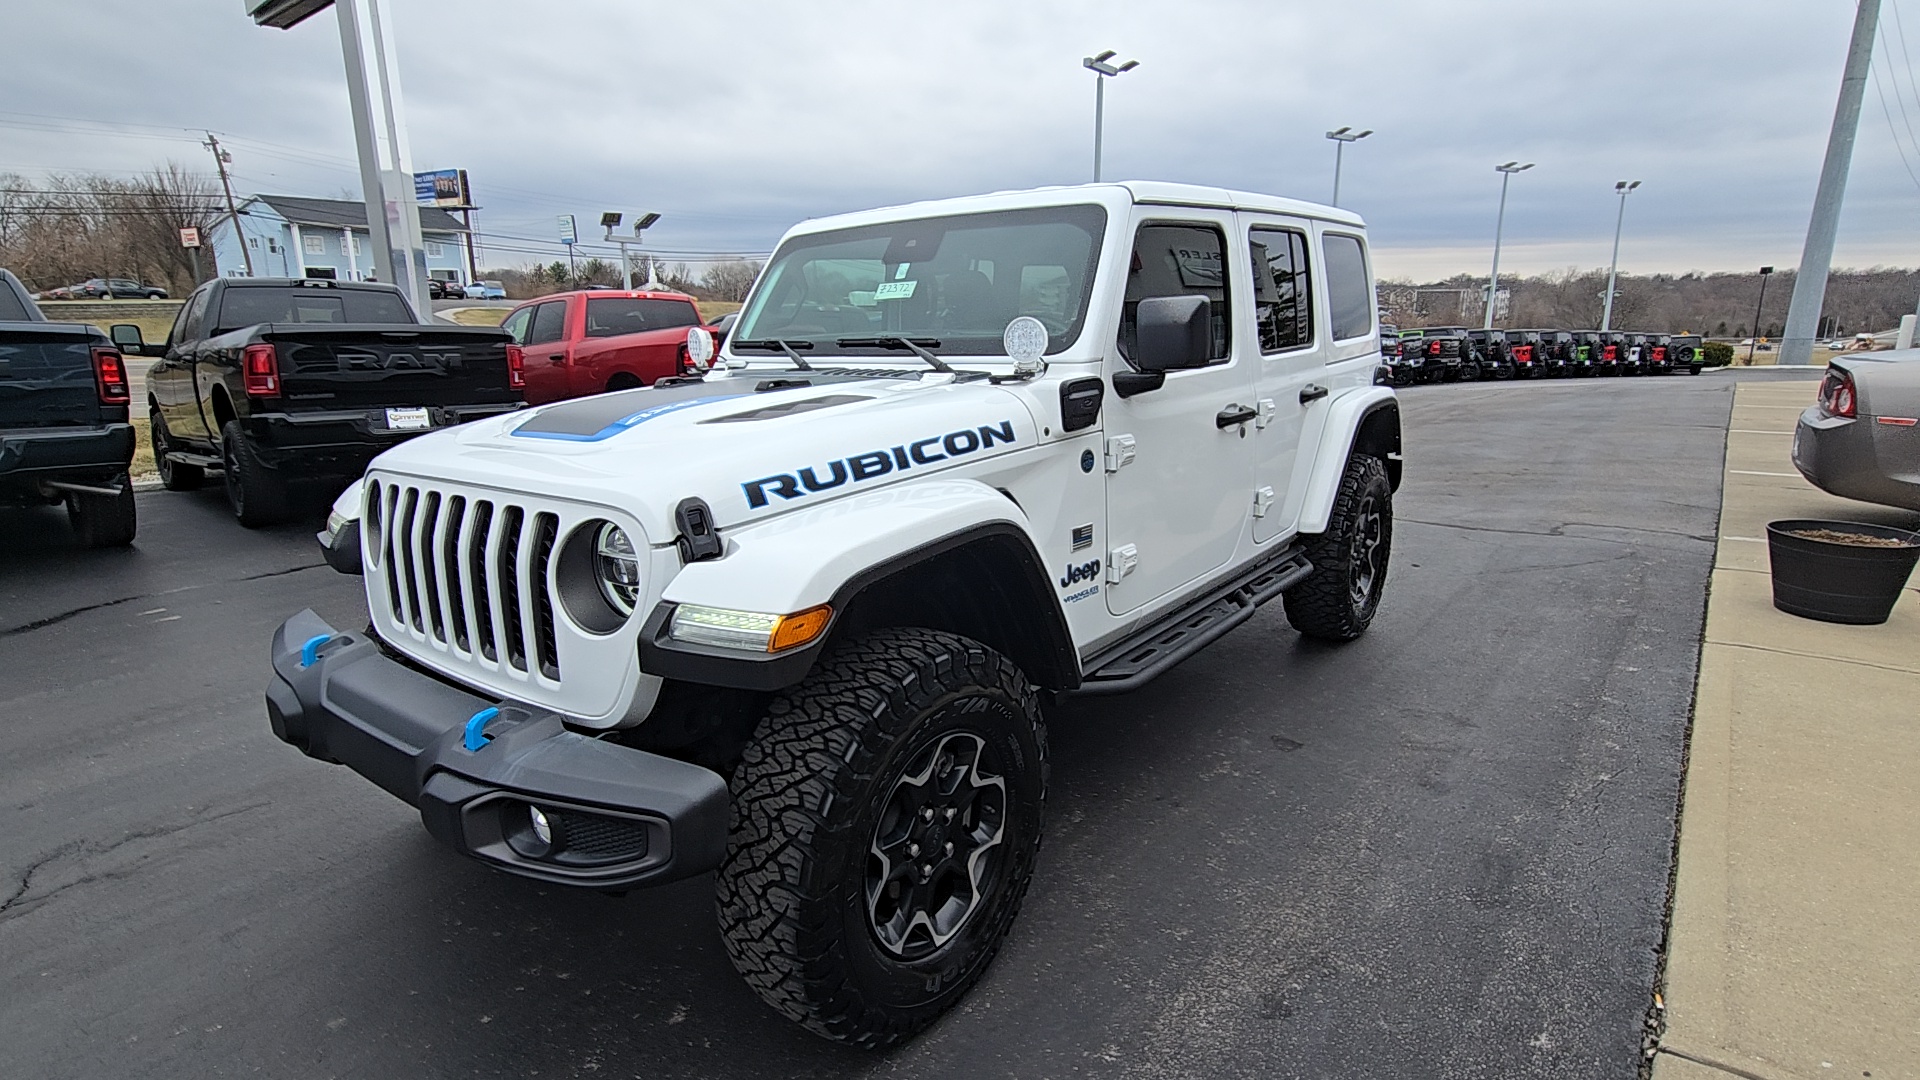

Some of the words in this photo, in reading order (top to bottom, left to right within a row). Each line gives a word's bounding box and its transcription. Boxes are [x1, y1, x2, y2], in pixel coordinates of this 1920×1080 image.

[337, 353, 462, 369] RAM
[739, 419, 1017, 510] RUBICON
[1060, 558, 1101, 588] Jeep
